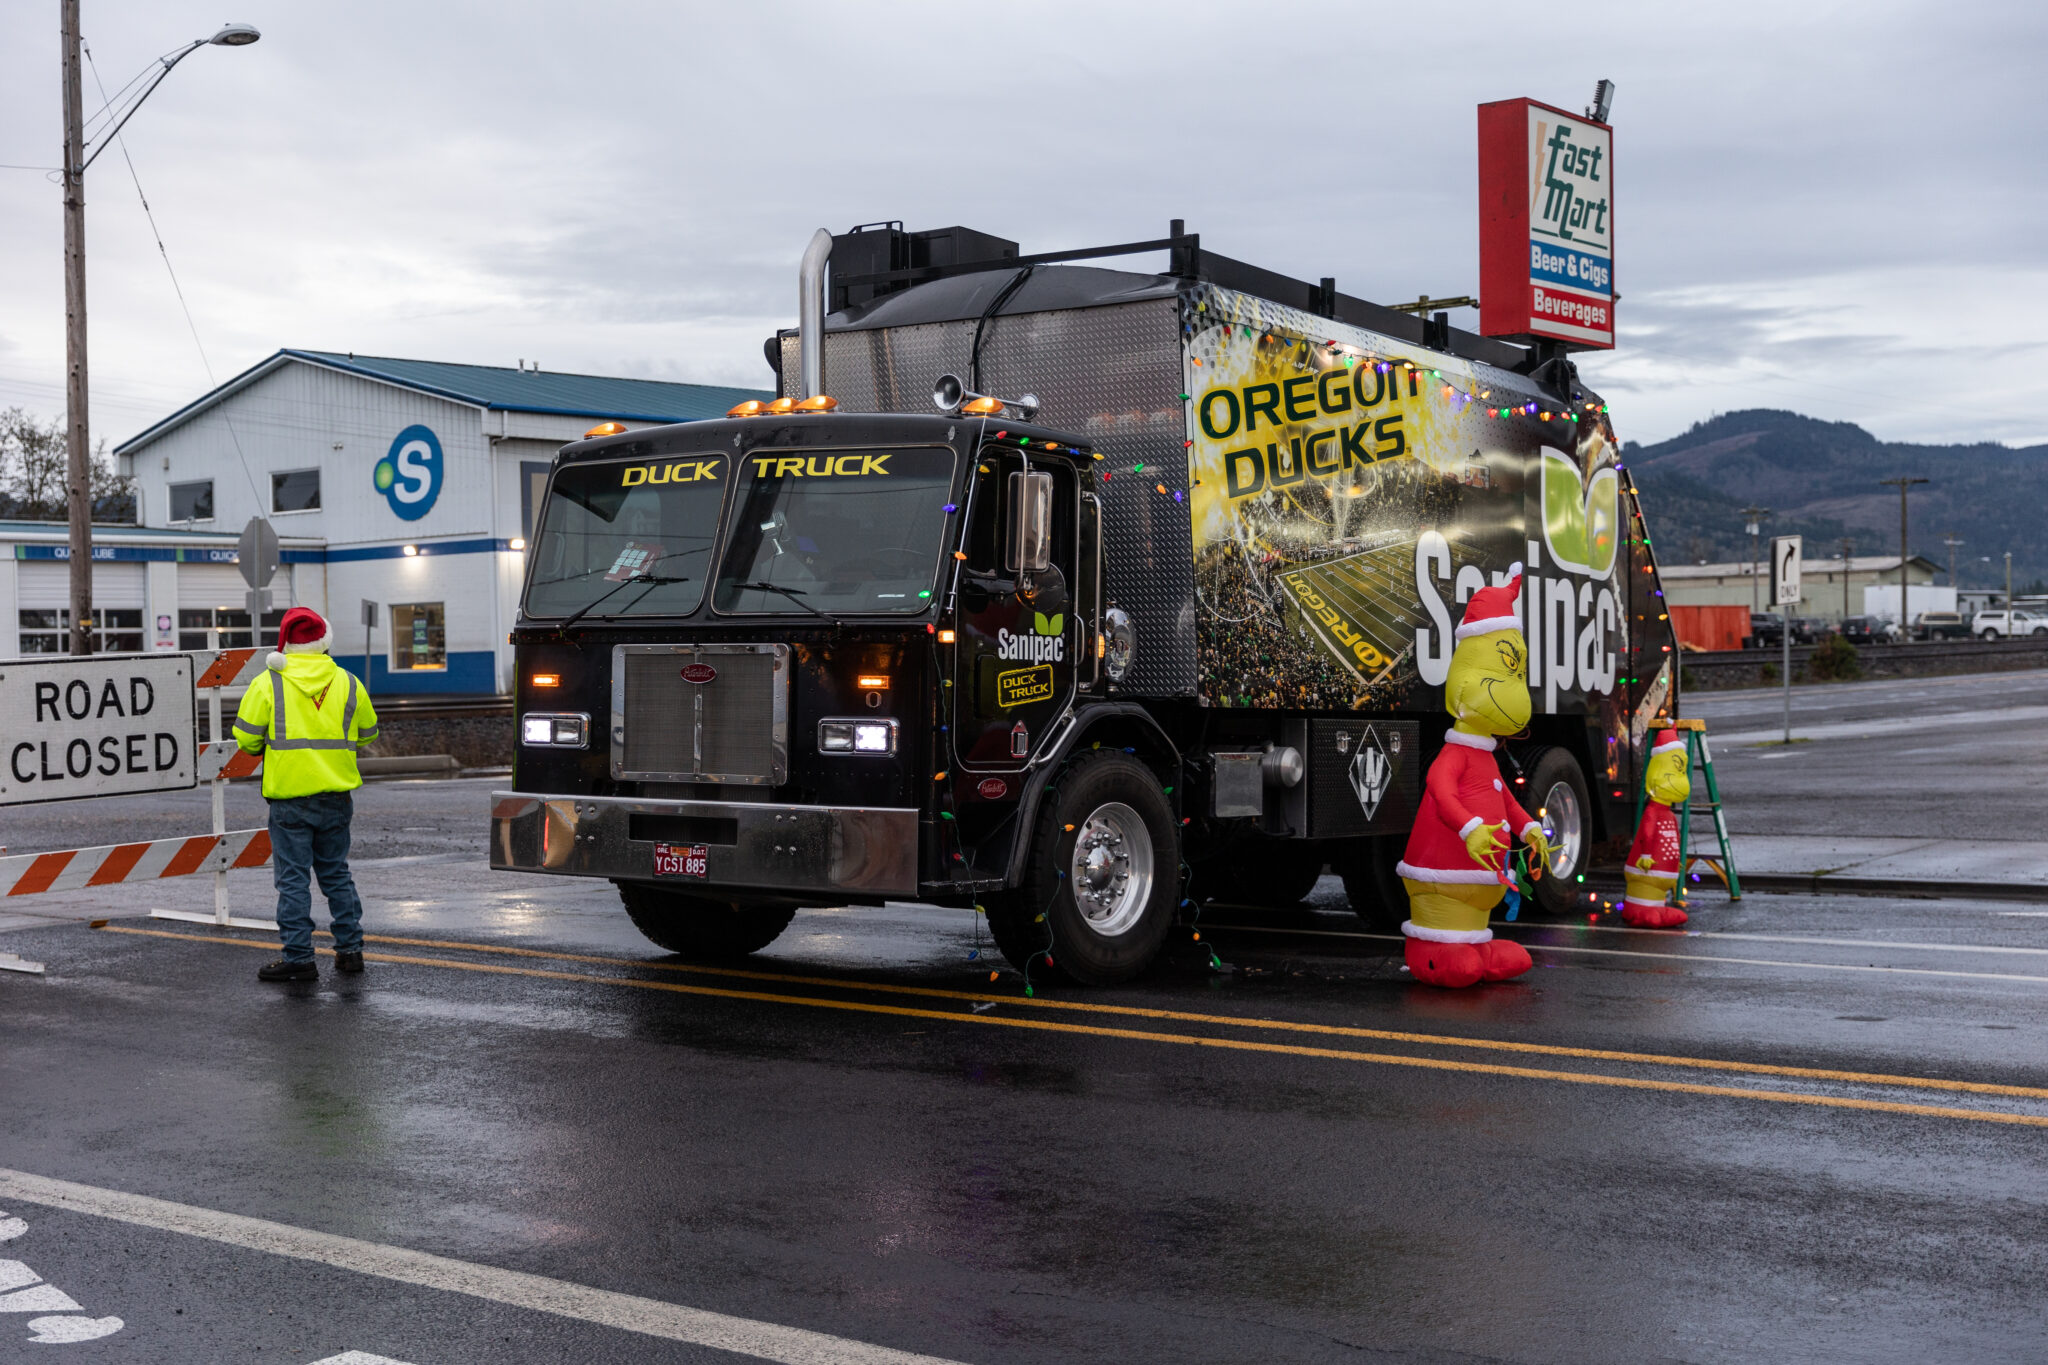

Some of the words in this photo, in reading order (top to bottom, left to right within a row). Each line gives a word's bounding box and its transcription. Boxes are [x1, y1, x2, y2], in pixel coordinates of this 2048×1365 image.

[1531, 244, 1565, 274] Beer
[1567, 254, 1578, 277] &
[1580, 257, 1608, 288] Cigs
[1533, 287, 1606, 327] Beverages
[394, 440, 432, 504] S
[622, 460, 720, 487] DUCK
[752, 454, 893, 478] TRUCK
[1225, 415, 1405, 498] DUCKS
[1781, 584, 1797, 598] ONLY
[998, 627, 1064, 666] Sanipac
[35, 677, 154, 722] ROAD
[1003, 674, 1036, 689] DUCK
[1009, 683, 1049, 699] TRUCK
[11, 732, 178, 783] CLOSED
